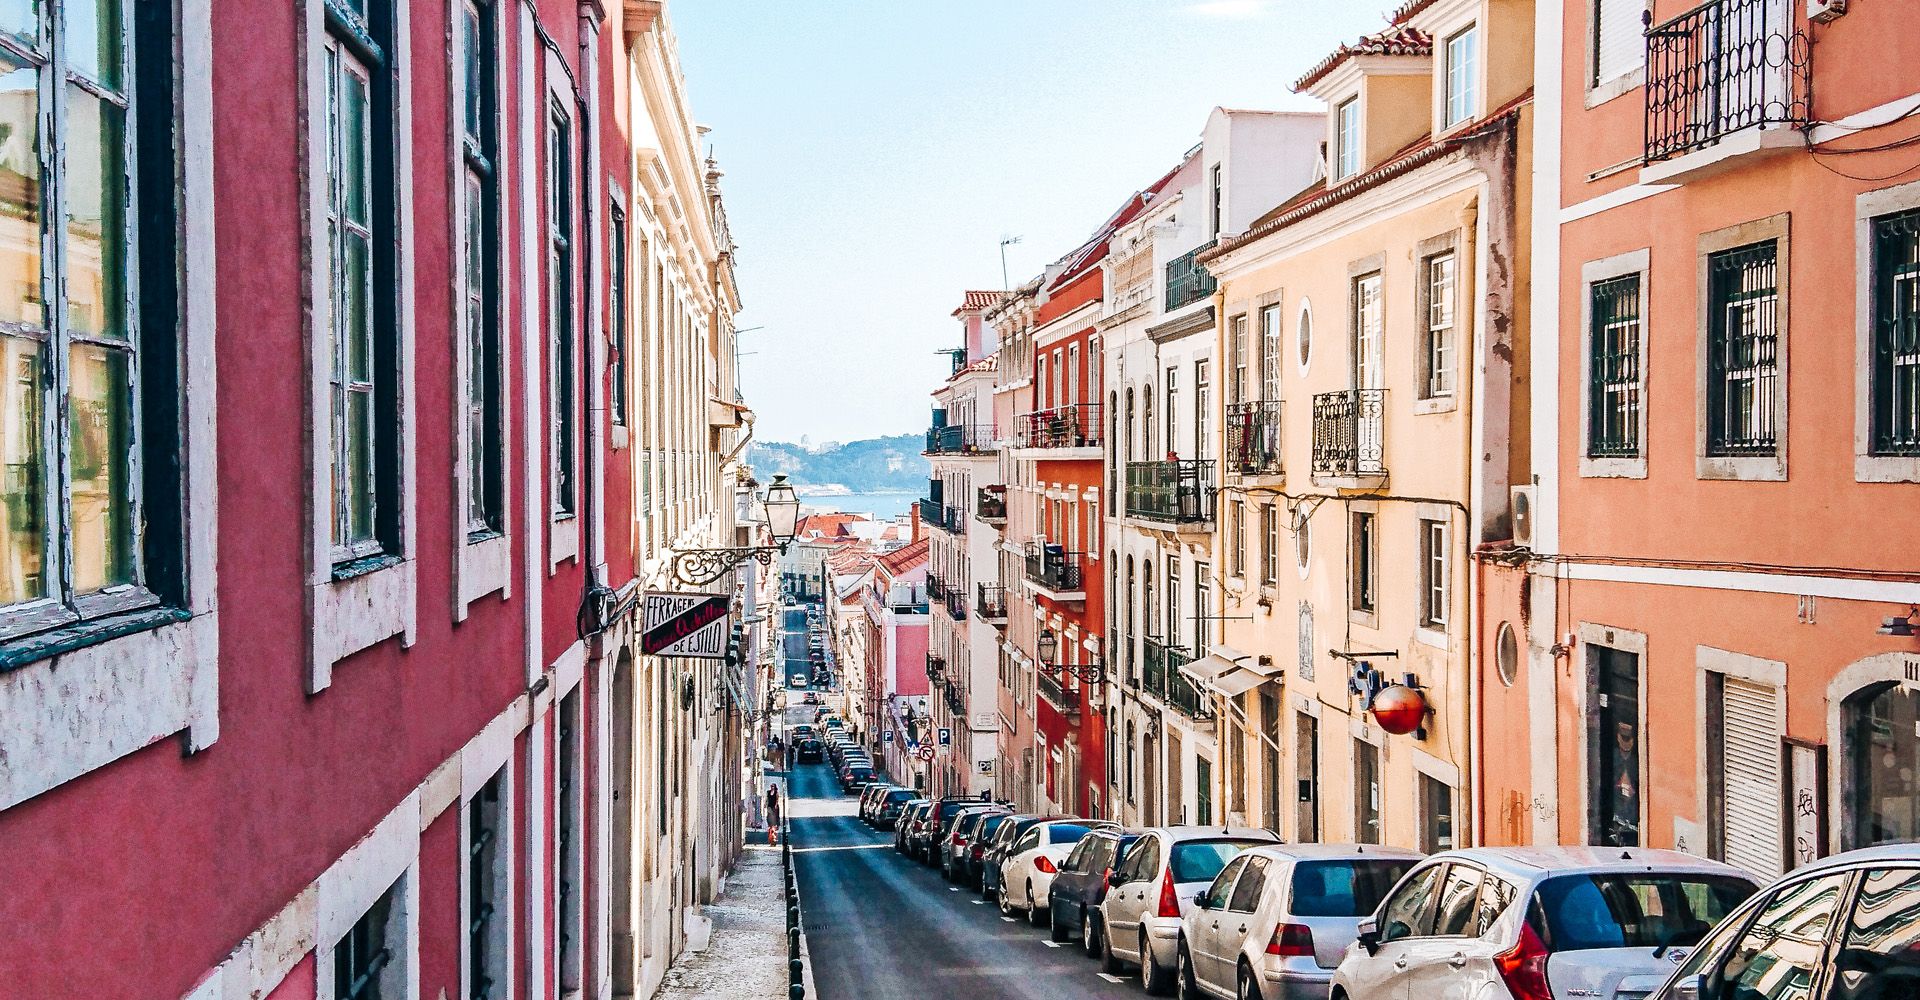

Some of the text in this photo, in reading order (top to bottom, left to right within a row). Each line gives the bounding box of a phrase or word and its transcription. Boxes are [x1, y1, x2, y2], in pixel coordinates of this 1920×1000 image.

[646, 596, 695, 631] FERRAGENS
[674, 640, 686, 653] DE
[688, 622, 721, 654] ESTILO
[885, 732, 892, 740] P
[940, 730, 948, 743] P
